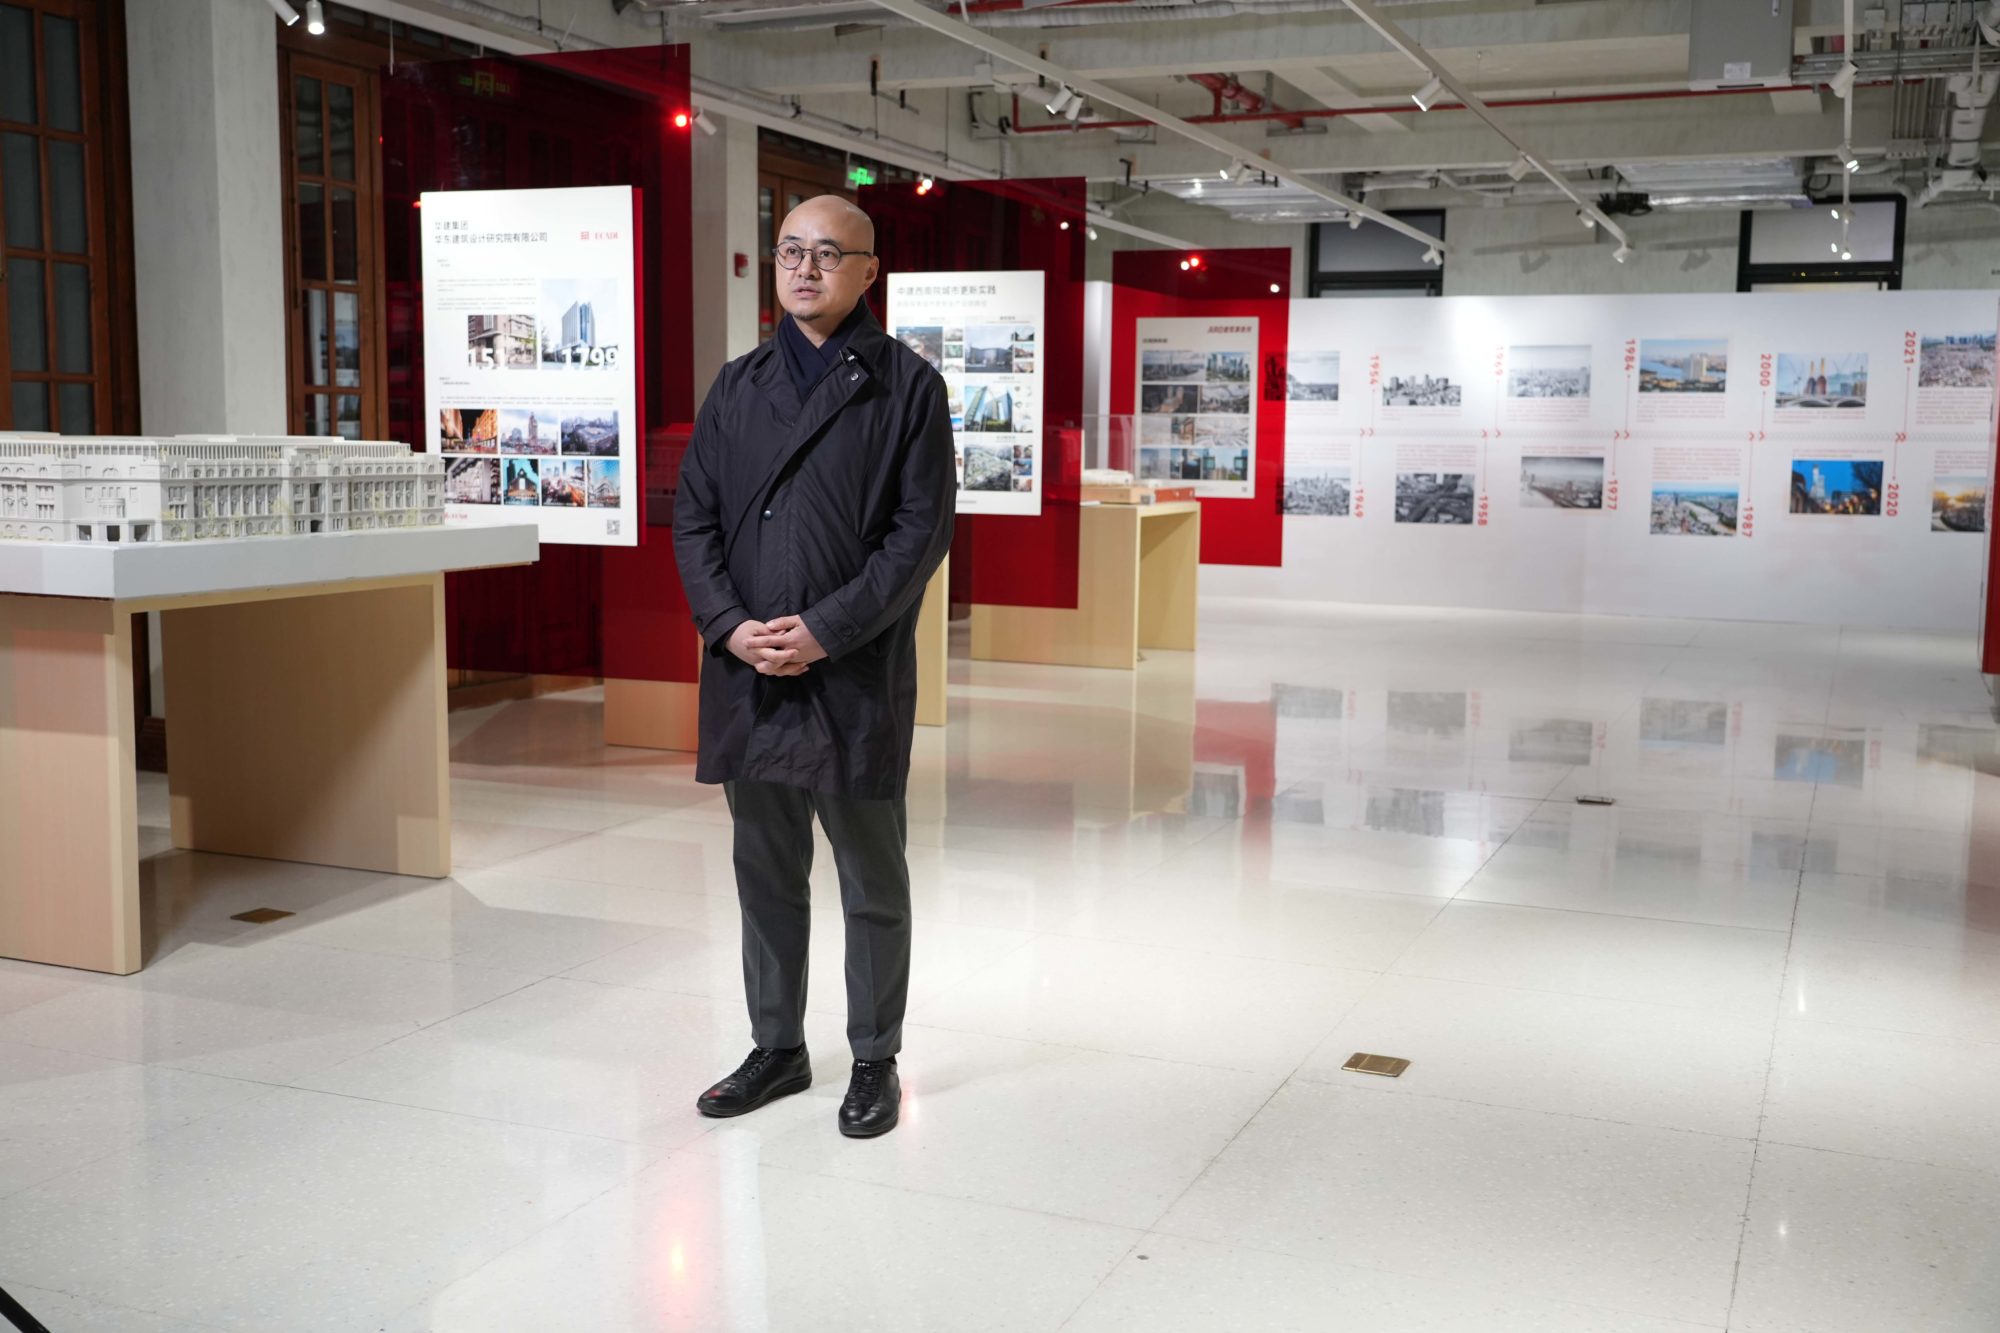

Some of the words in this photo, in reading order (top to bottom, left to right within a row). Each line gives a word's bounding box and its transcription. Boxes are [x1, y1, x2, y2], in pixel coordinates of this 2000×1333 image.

[435, 232, 548, 243] 华东建筑设计研究院有限公司
[561, 347, 619, 371] 1799
[1625, 339, 1635, 371] 1984
[1904, 331, 1916, 364] 2021
[1370, 355, 1380, 385] 1954
[1760, 353, 1771, 387] 2000
[1478, 495, 1488, 526] 1958
[1607, 480, 1618, 510] 1977
[1886, 483, 1899, 517] 2020
[1742, 506, 1753, 538] 1987
